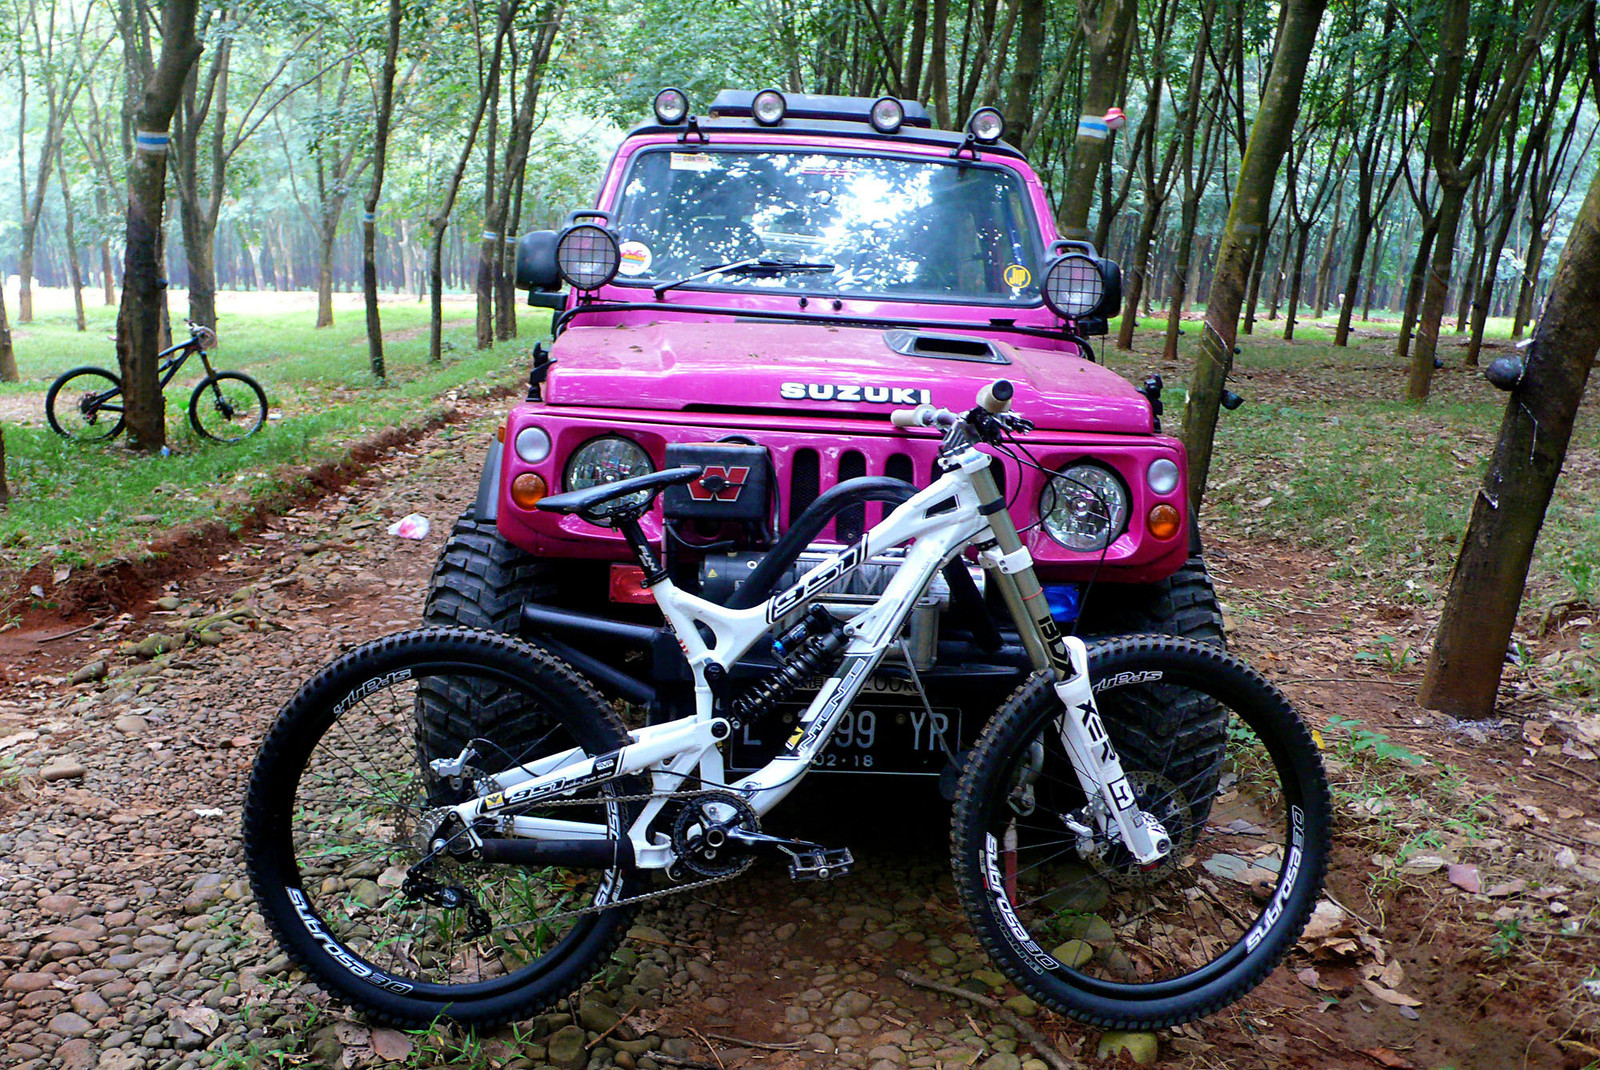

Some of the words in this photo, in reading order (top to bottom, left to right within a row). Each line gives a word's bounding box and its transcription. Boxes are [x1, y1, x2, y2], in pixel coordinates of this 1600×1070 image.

[780, 382, 932, 405] SUZUKI
[797, 657, 867, 753] INTENSE
[834, 710, 876, 749] 99
[910, 711, 949, 751] YR
